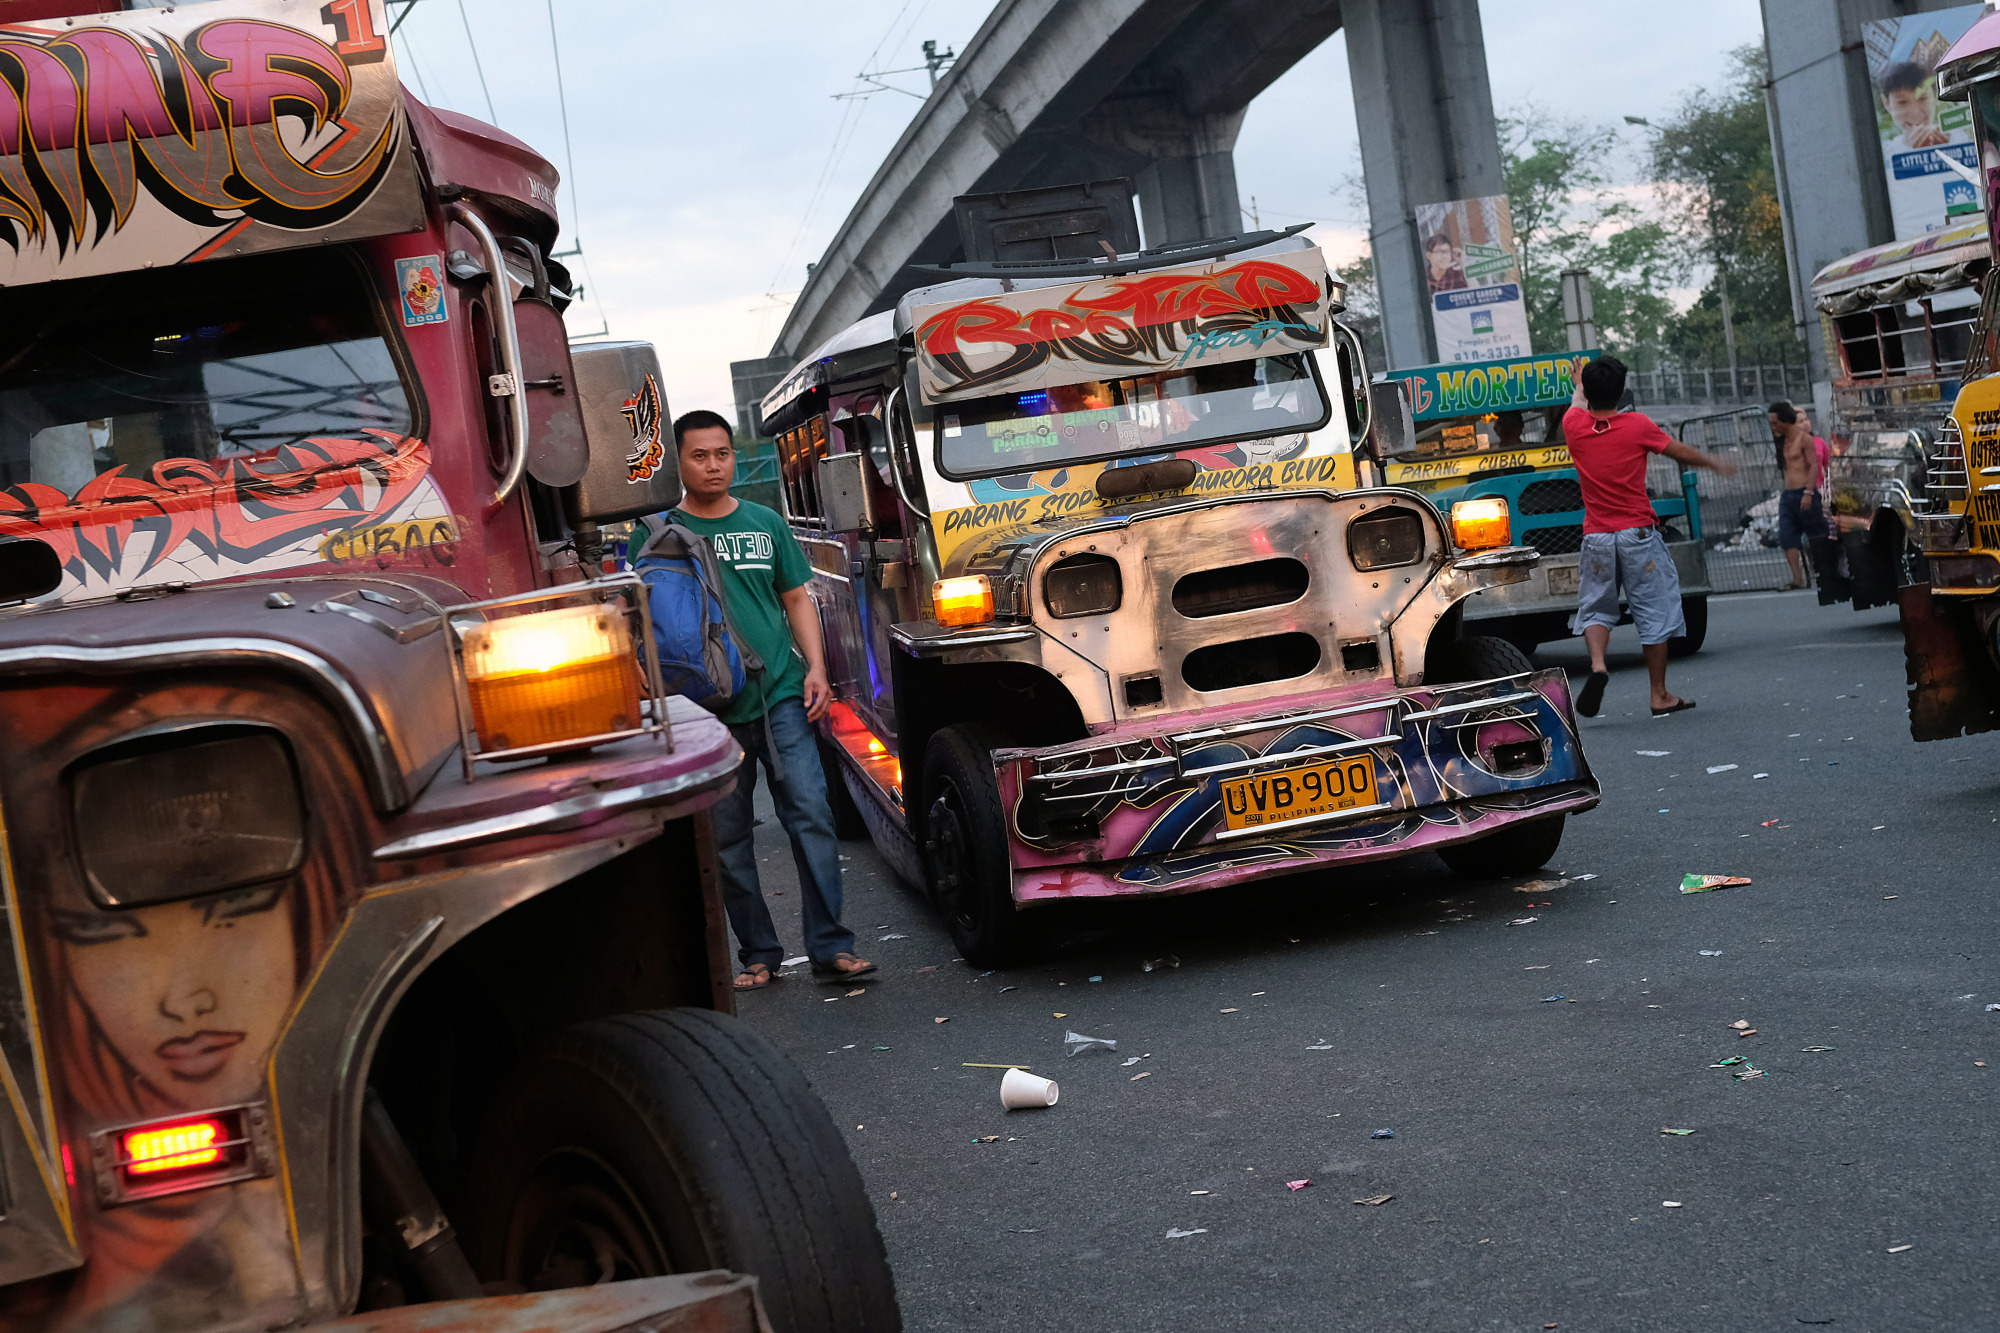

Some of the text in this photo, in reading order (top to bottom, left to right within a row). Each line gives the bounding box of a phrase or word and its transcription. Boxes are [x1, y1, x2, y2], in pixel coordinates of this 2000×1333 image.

[1901, 152, 1930, 168] LITTLE
[401, 258, 434, 268] PNP
[1400, 460, 1461, 480] PARANG
[1478, 452, 1527, 472] CUBAO
[943, 497, 1029, 535] PARANG
[1040, 489, 1094, 517] STOP
[1191, 465, 1274, 493] AURORA
[1281, 456, 1337, 485] BLVD.
[1269, 803, 1334, 822] PILIPINAS
